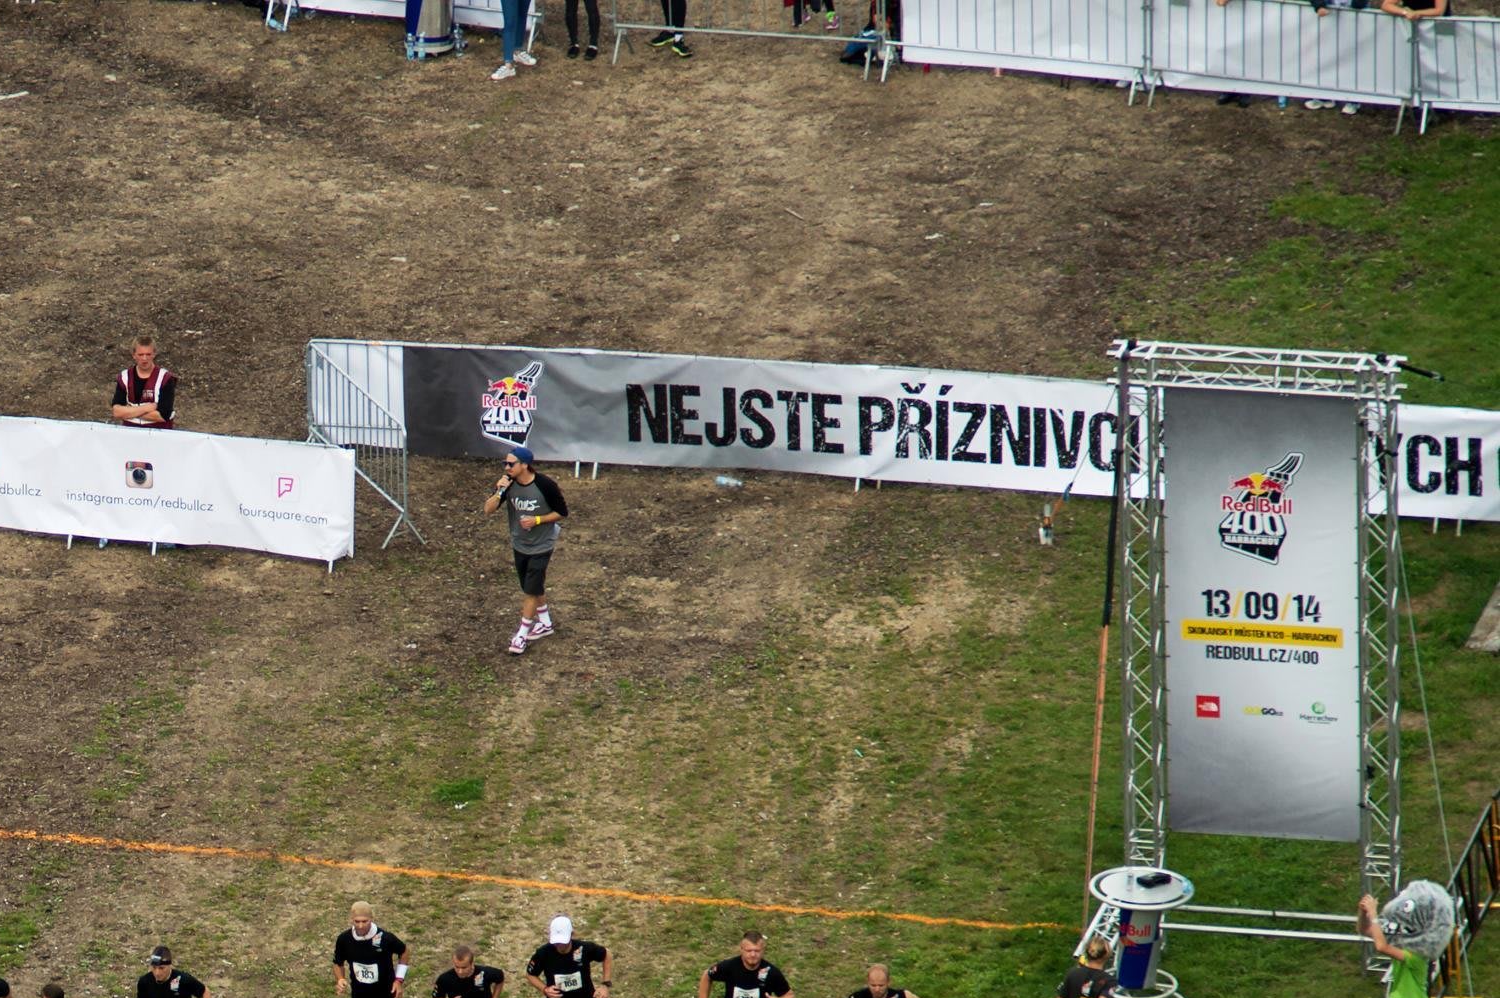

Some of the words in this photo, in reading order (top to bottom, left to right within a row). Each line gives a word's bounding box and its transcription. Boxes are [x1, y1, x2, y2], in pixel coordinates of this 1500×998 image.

[482, 394, 509, 408] Red
[511, 396, 537, 410] Bull
[483, 407, 531, 425] 400
[626, 383, 843, 454] NEJSTE
[66, 490, 214, 512] instagram.com/redbullcz
[1222, 496, 1256, 512] Red
[1259, 498, 1292, 514] Bull
[239, 503, 328, 526] foursquare.com
[1221, 511, 1285, 537] 400
[1225, 535, 1280, 546] HARRACHOV
[1292, 632, 1338, 643] HARRACHOV
[1206, 645, 1319, 665] REDBULL.CZ/400
